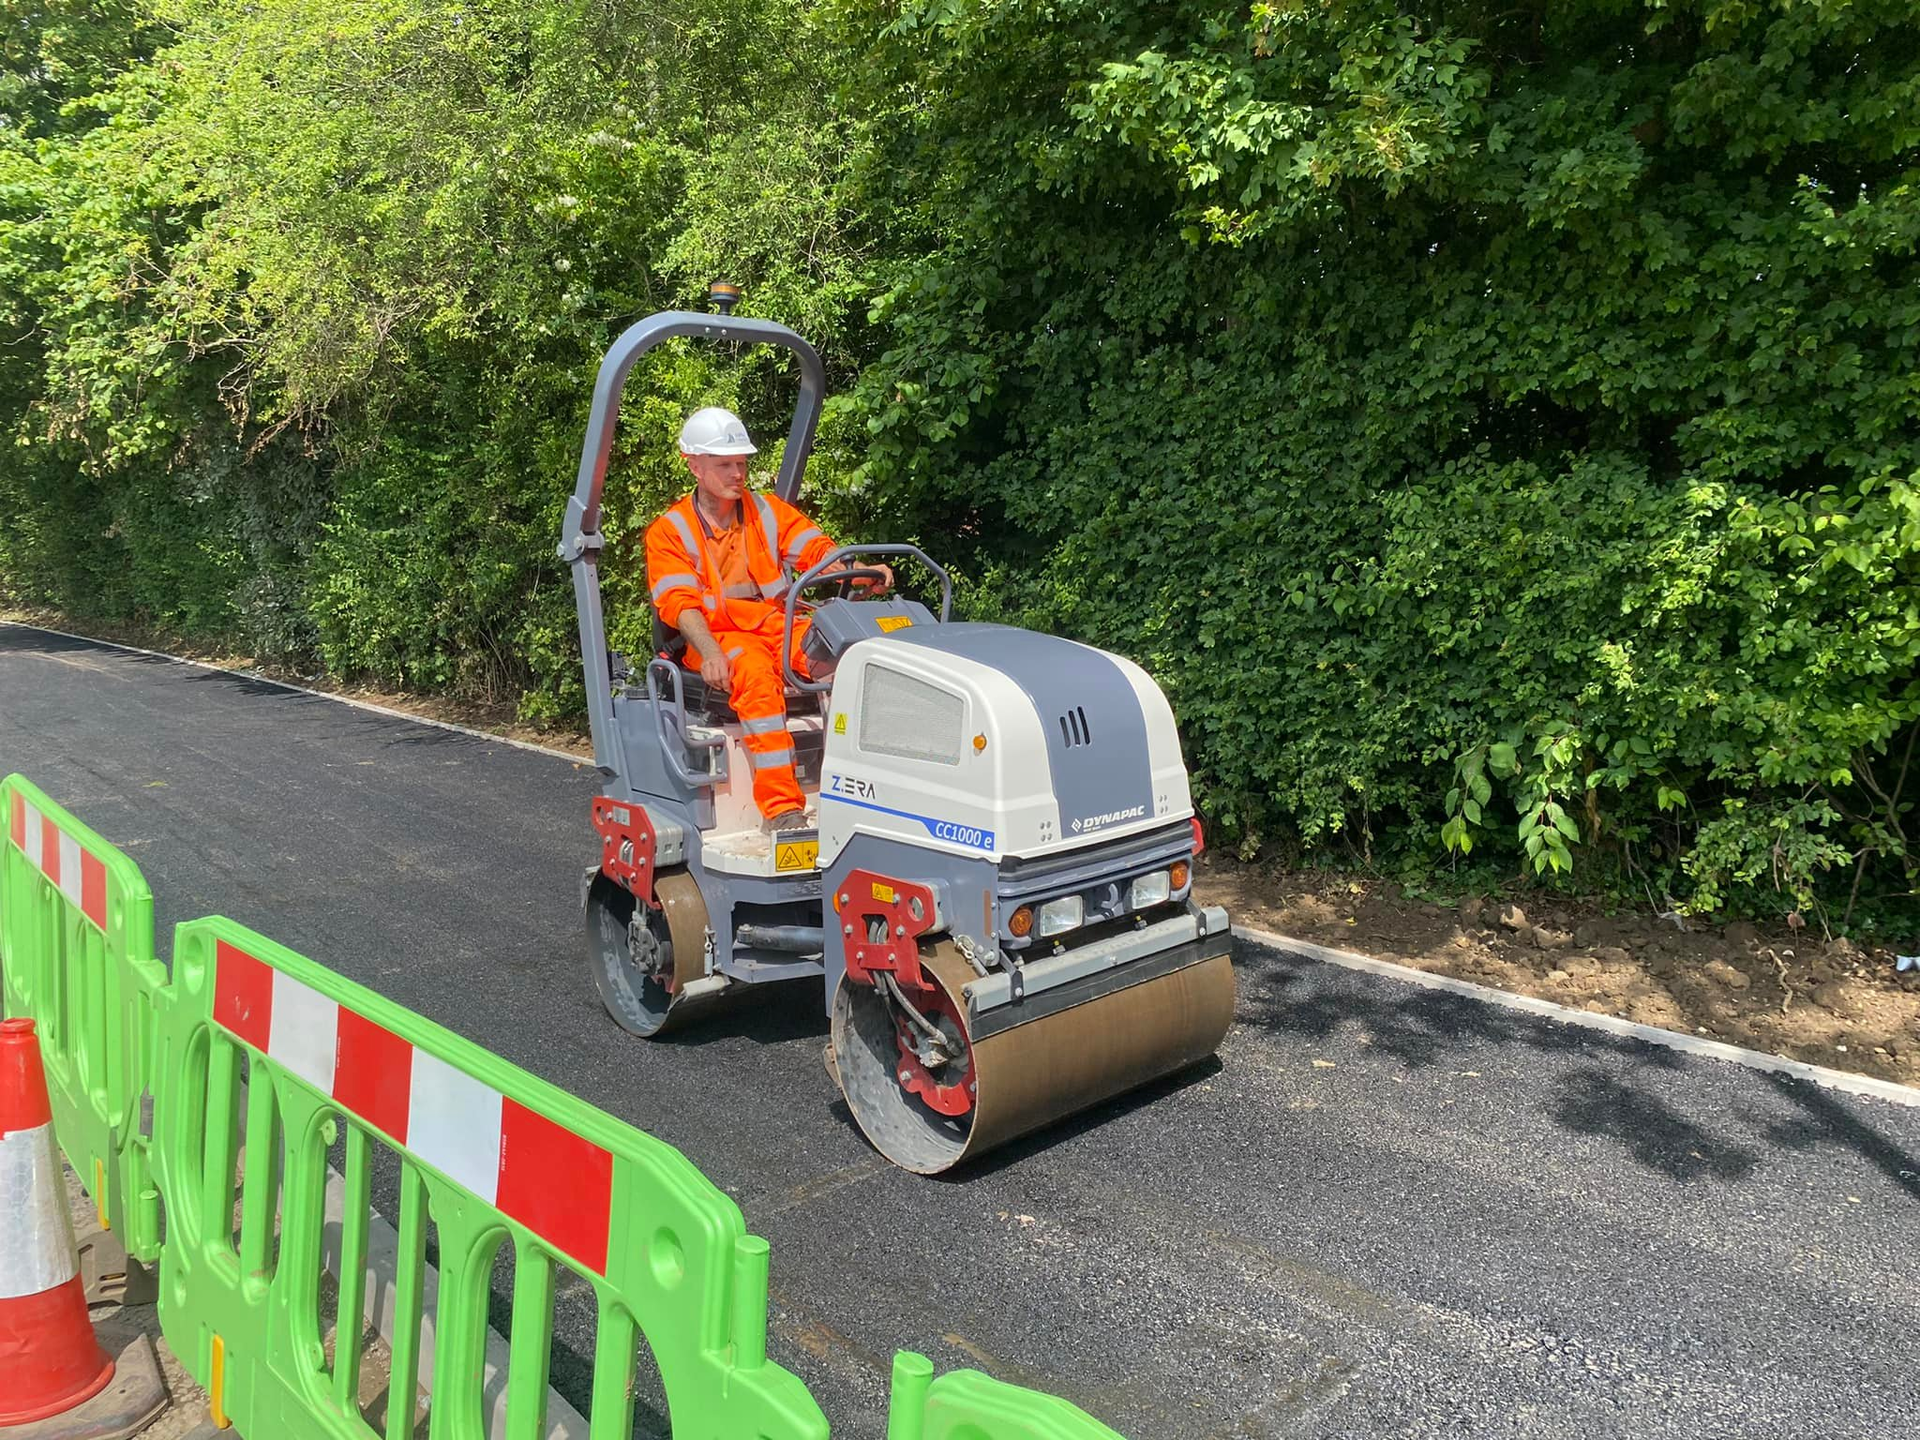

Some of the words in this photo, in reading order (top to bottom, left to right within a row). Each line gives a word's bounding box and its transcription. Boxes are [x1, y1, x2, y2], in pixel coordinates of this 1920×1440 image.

[1083, 805, 1145, 829] DYNAPAC
[935, 822, 982, 846] CC1000
[984, 836, 993, 849] e
